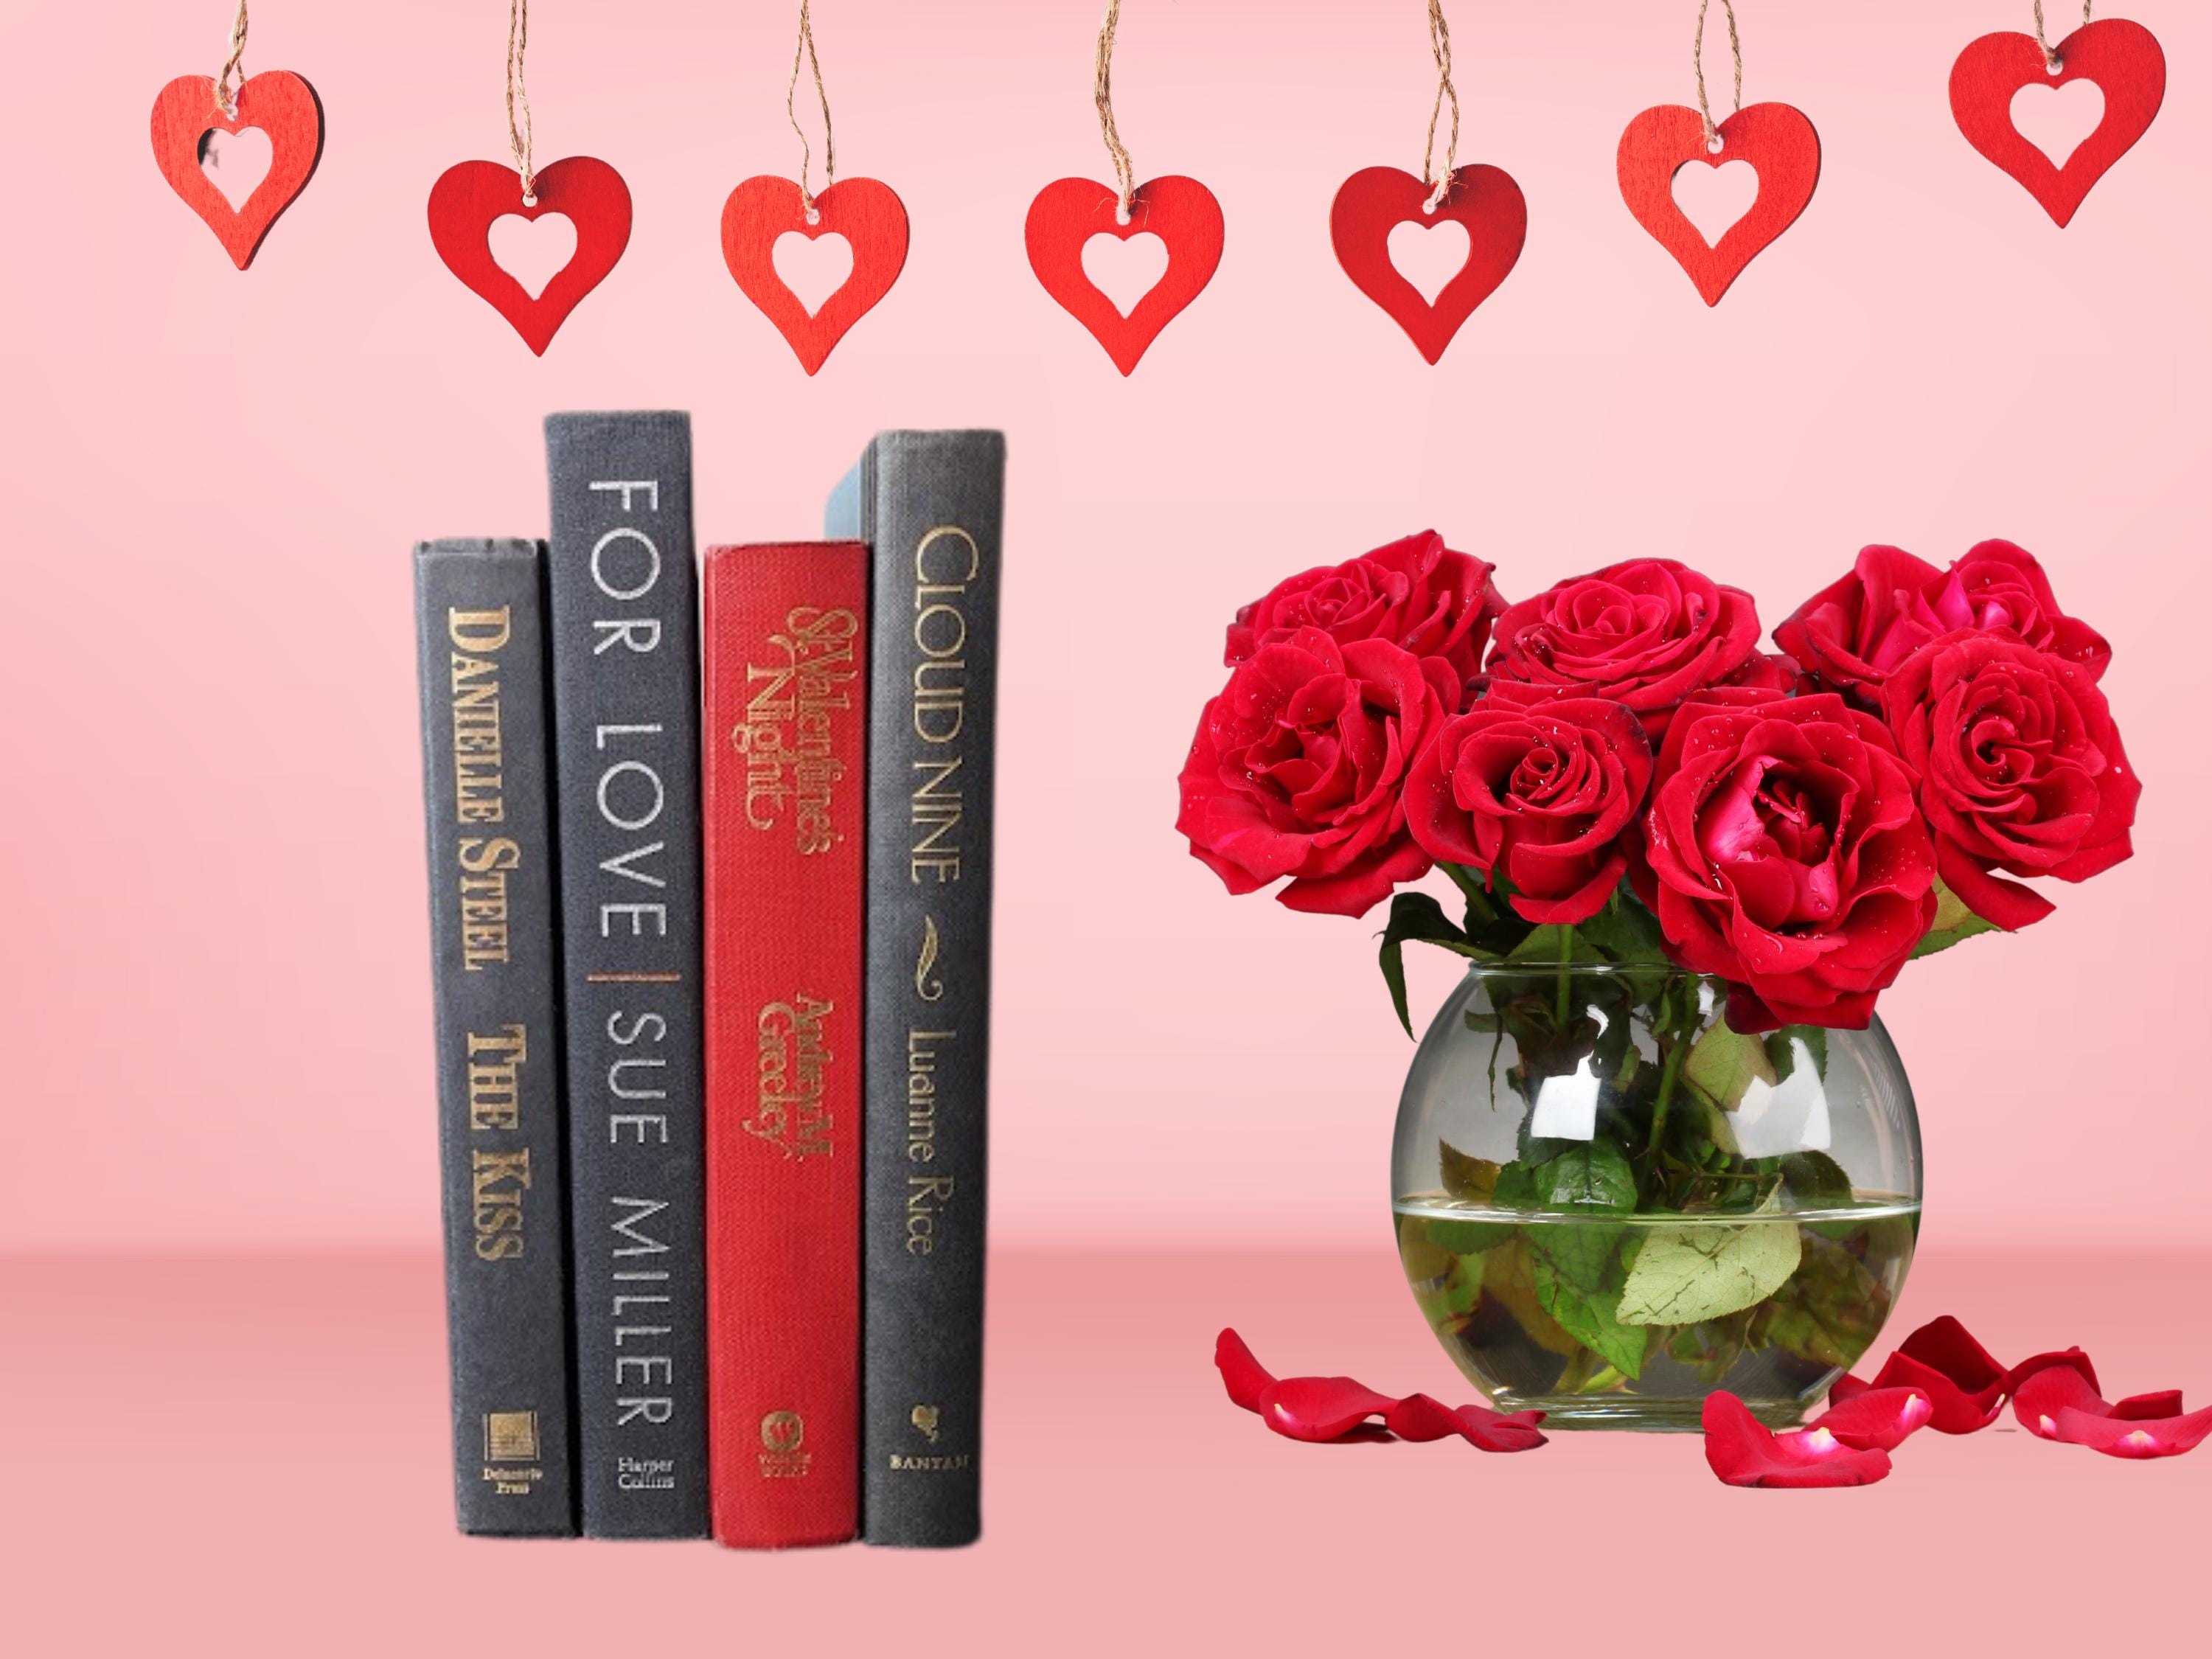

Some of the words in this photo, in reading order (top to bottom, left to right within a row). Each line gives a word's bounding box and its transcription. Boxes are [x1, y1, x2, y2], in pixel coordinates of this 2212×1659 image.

[589, 480, 661, 655] FOR
[914, 525, 979, 744] CLOUD
[448, 605, 511, 826] DANIELLE
[731, 634, 798, 831] Night
[596, 723, 667, 937] LOVE
[911, 757, 964, 884] NINE
[458, 836, 521, 972] STEEL
[467, 1023, 526, 1130] THE
[607, 1009, 669, 1144] SUE
[742, 1001, 803, 1161] Greeley
[908, 1030, 957, 1163] Luanne
[472, 1147, 532, 1262] KISS
[906, 1175, 955, 1255] Rice
[610, 1196, 673, 1427] MILLER
[618, 1456, 674, 1474] Harper
[618, 1472, 675, 1489] Collins
